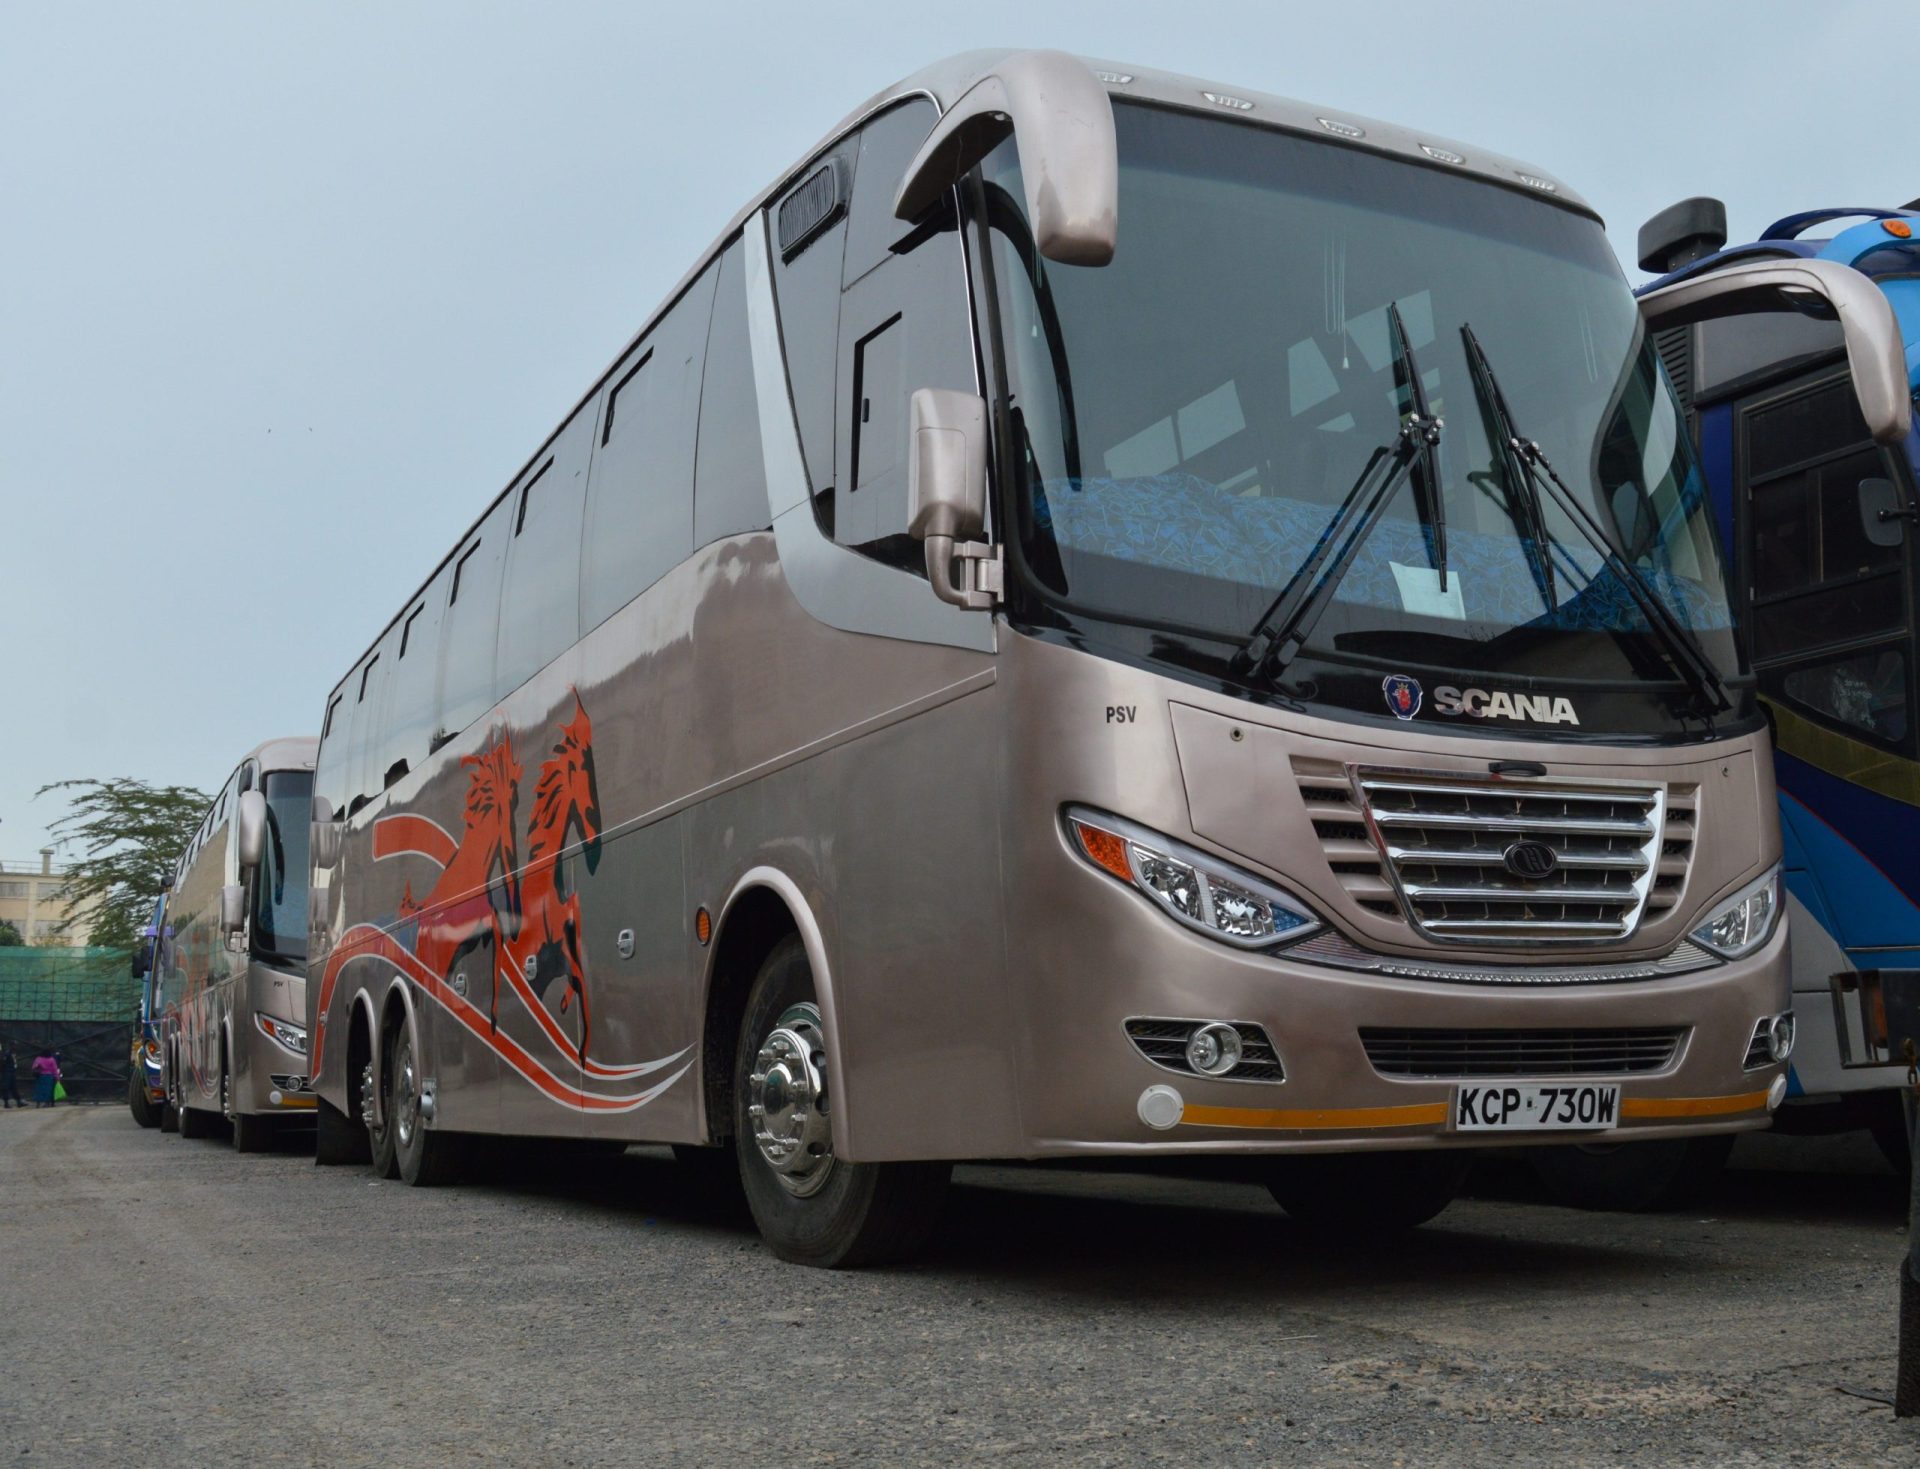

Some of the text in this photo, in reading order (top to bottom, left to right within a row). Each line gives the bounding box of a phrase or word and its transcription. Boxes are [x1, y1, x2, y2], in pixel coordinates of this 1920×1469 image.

[1106, 705, 1137, 723] PSV
[1433, 685, 1580, 725] SCANIA
[1458, 1088, 1616, 1125] KCP 730W
